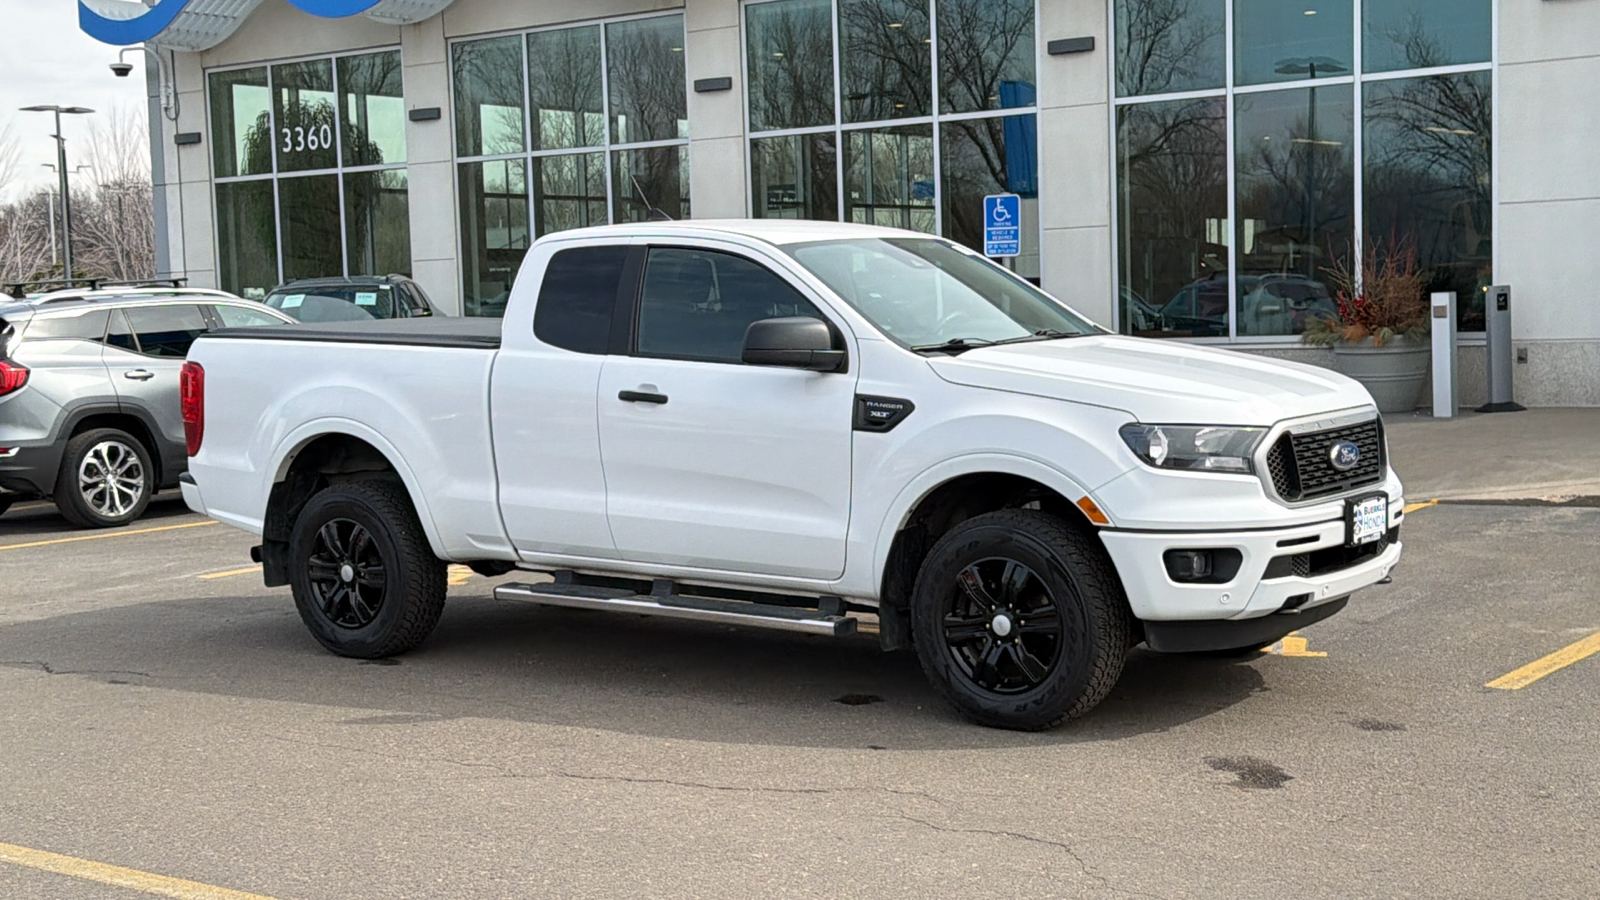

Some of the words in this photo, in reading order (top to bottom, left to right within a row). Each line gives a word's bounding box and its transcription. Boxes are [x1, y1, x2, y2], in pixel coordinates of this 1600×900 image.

[282, 124, 332, 153] 3360
[866, 401, 903, 409] RANGER
[870, 410, 890, 418] XLT
[1341, 447, 1356, 462] Ford
[1364, 514, 1385, 530] HONDA
